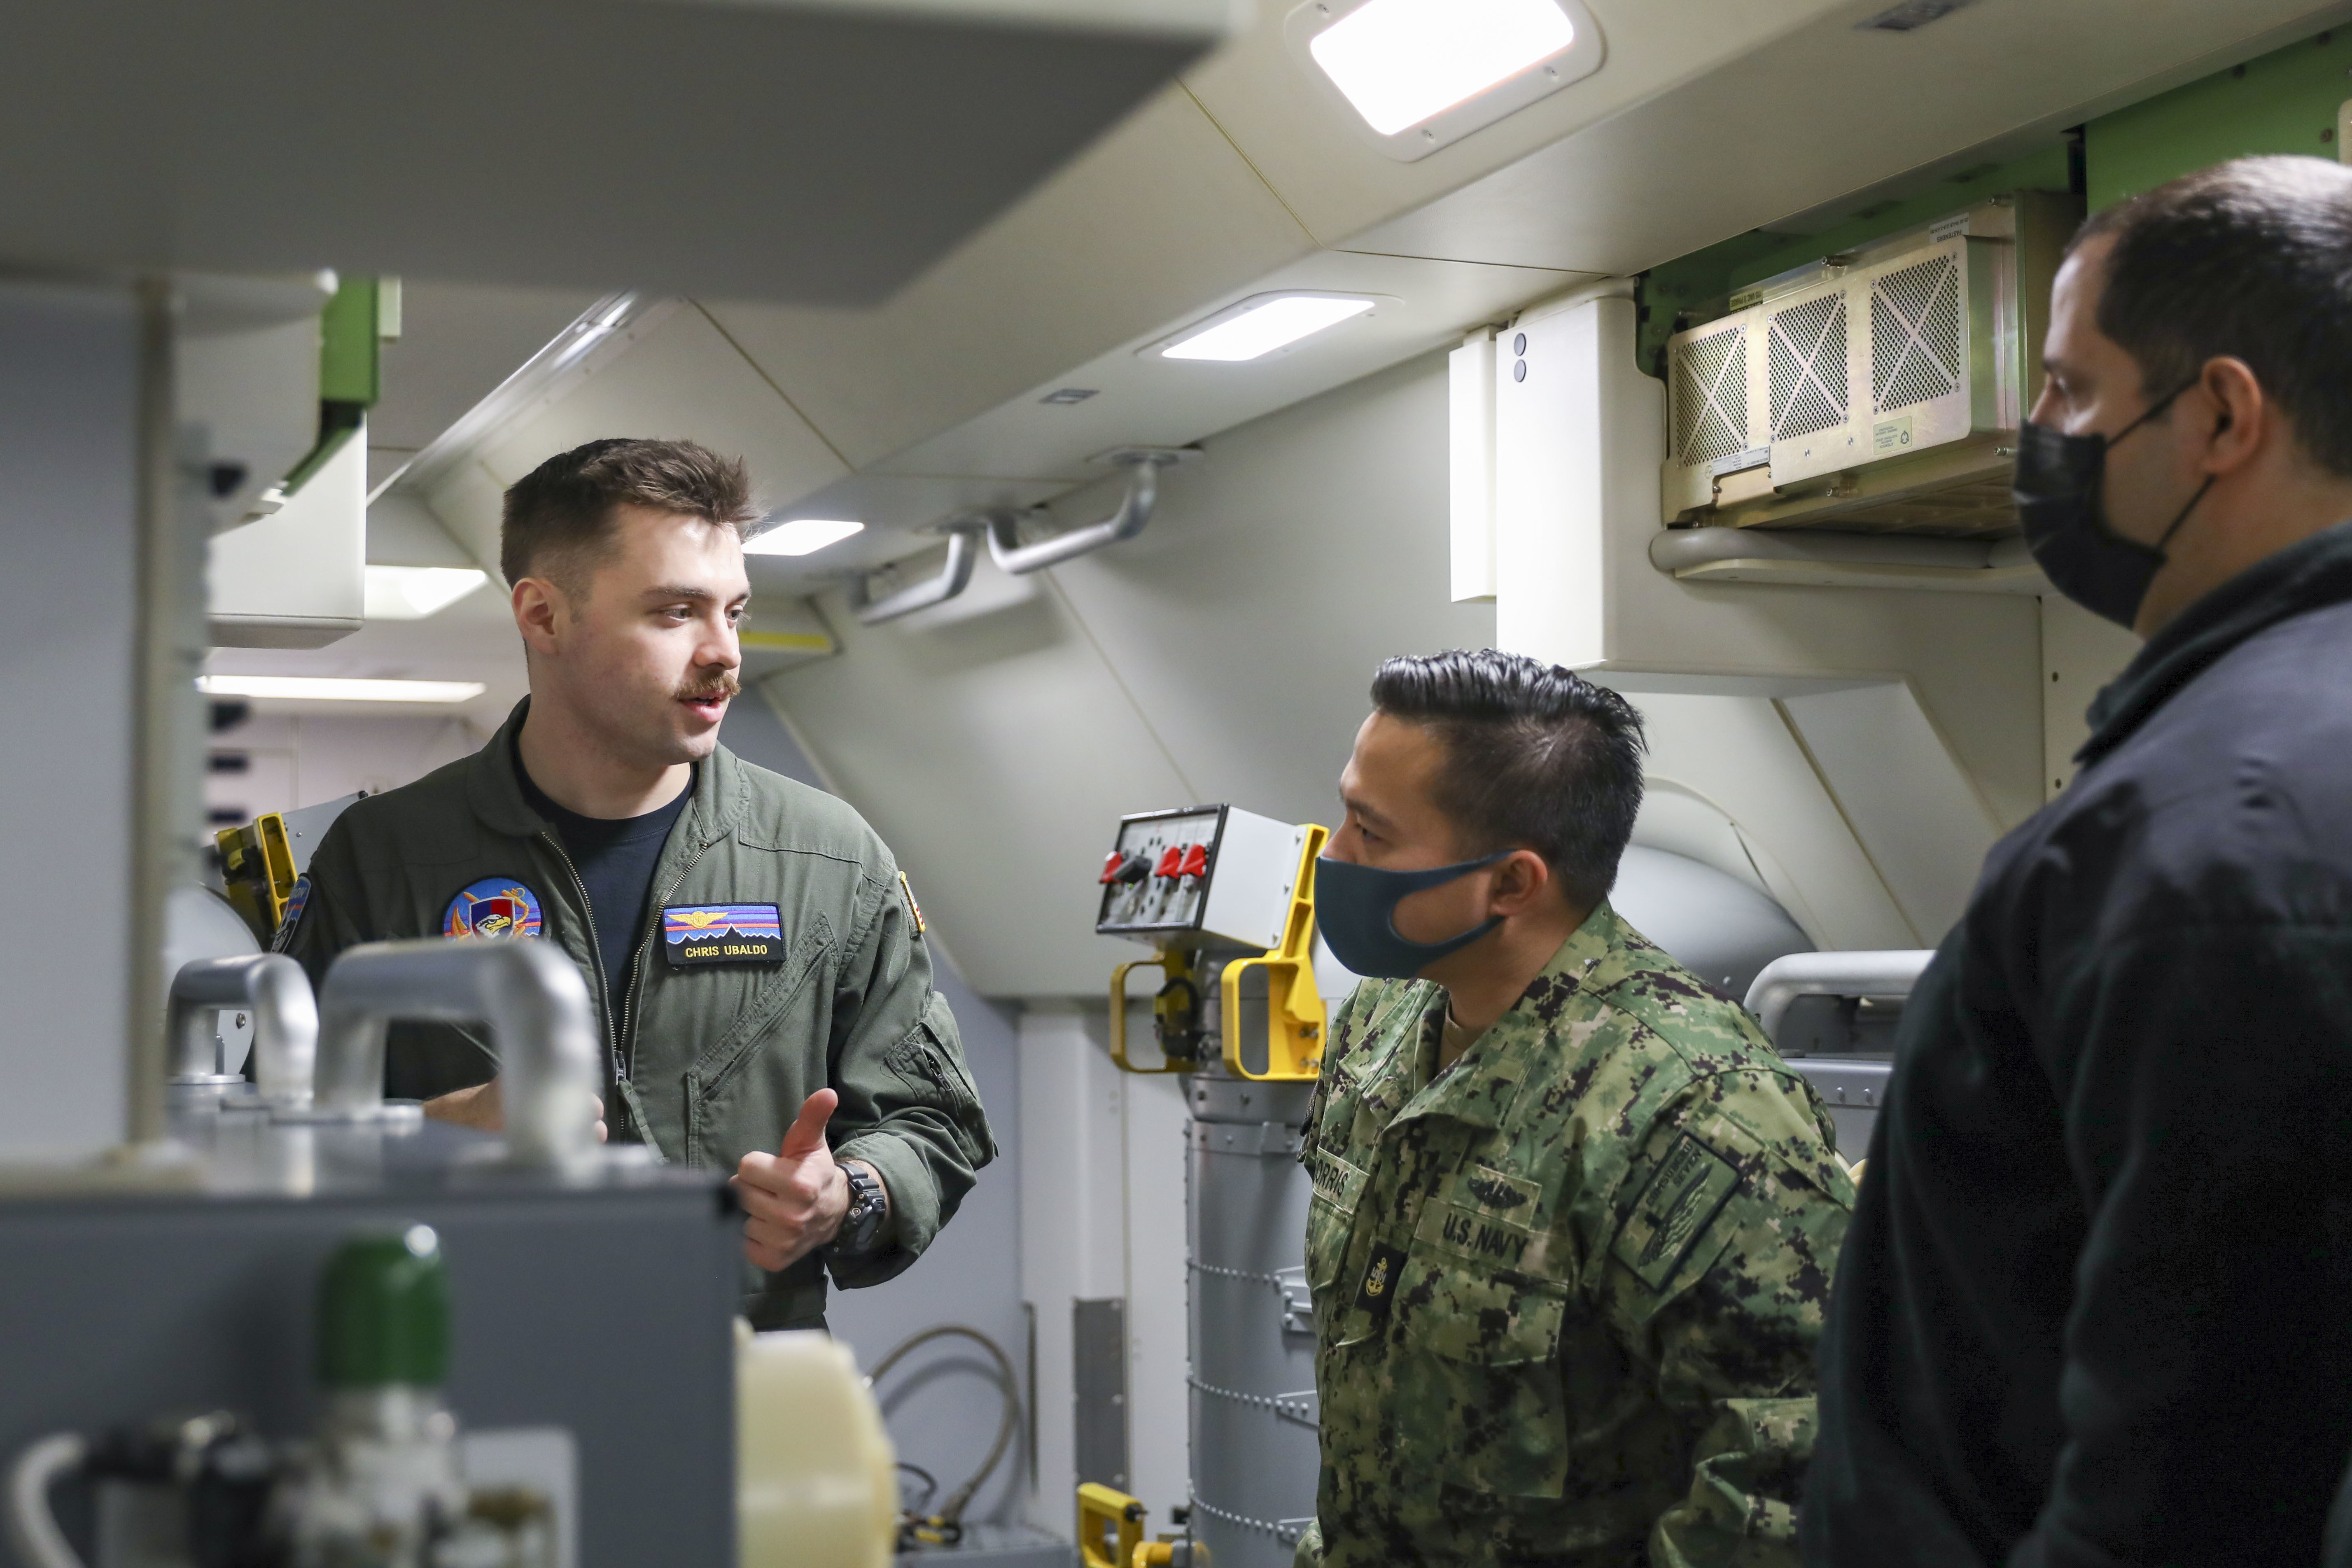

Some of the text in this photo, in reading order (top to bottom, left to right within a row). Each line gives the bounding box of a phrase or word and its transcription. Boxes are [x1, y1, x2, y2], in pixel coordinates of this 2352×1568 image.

[1937, 229, 1962, 243] FASTENERS
[685, 945, 768, 958] CHRIS UBALDO
[1316, 1158, 1348, 1197] ORRIS
[1443, 1212, 1529, 1264] U.S. NAVY
